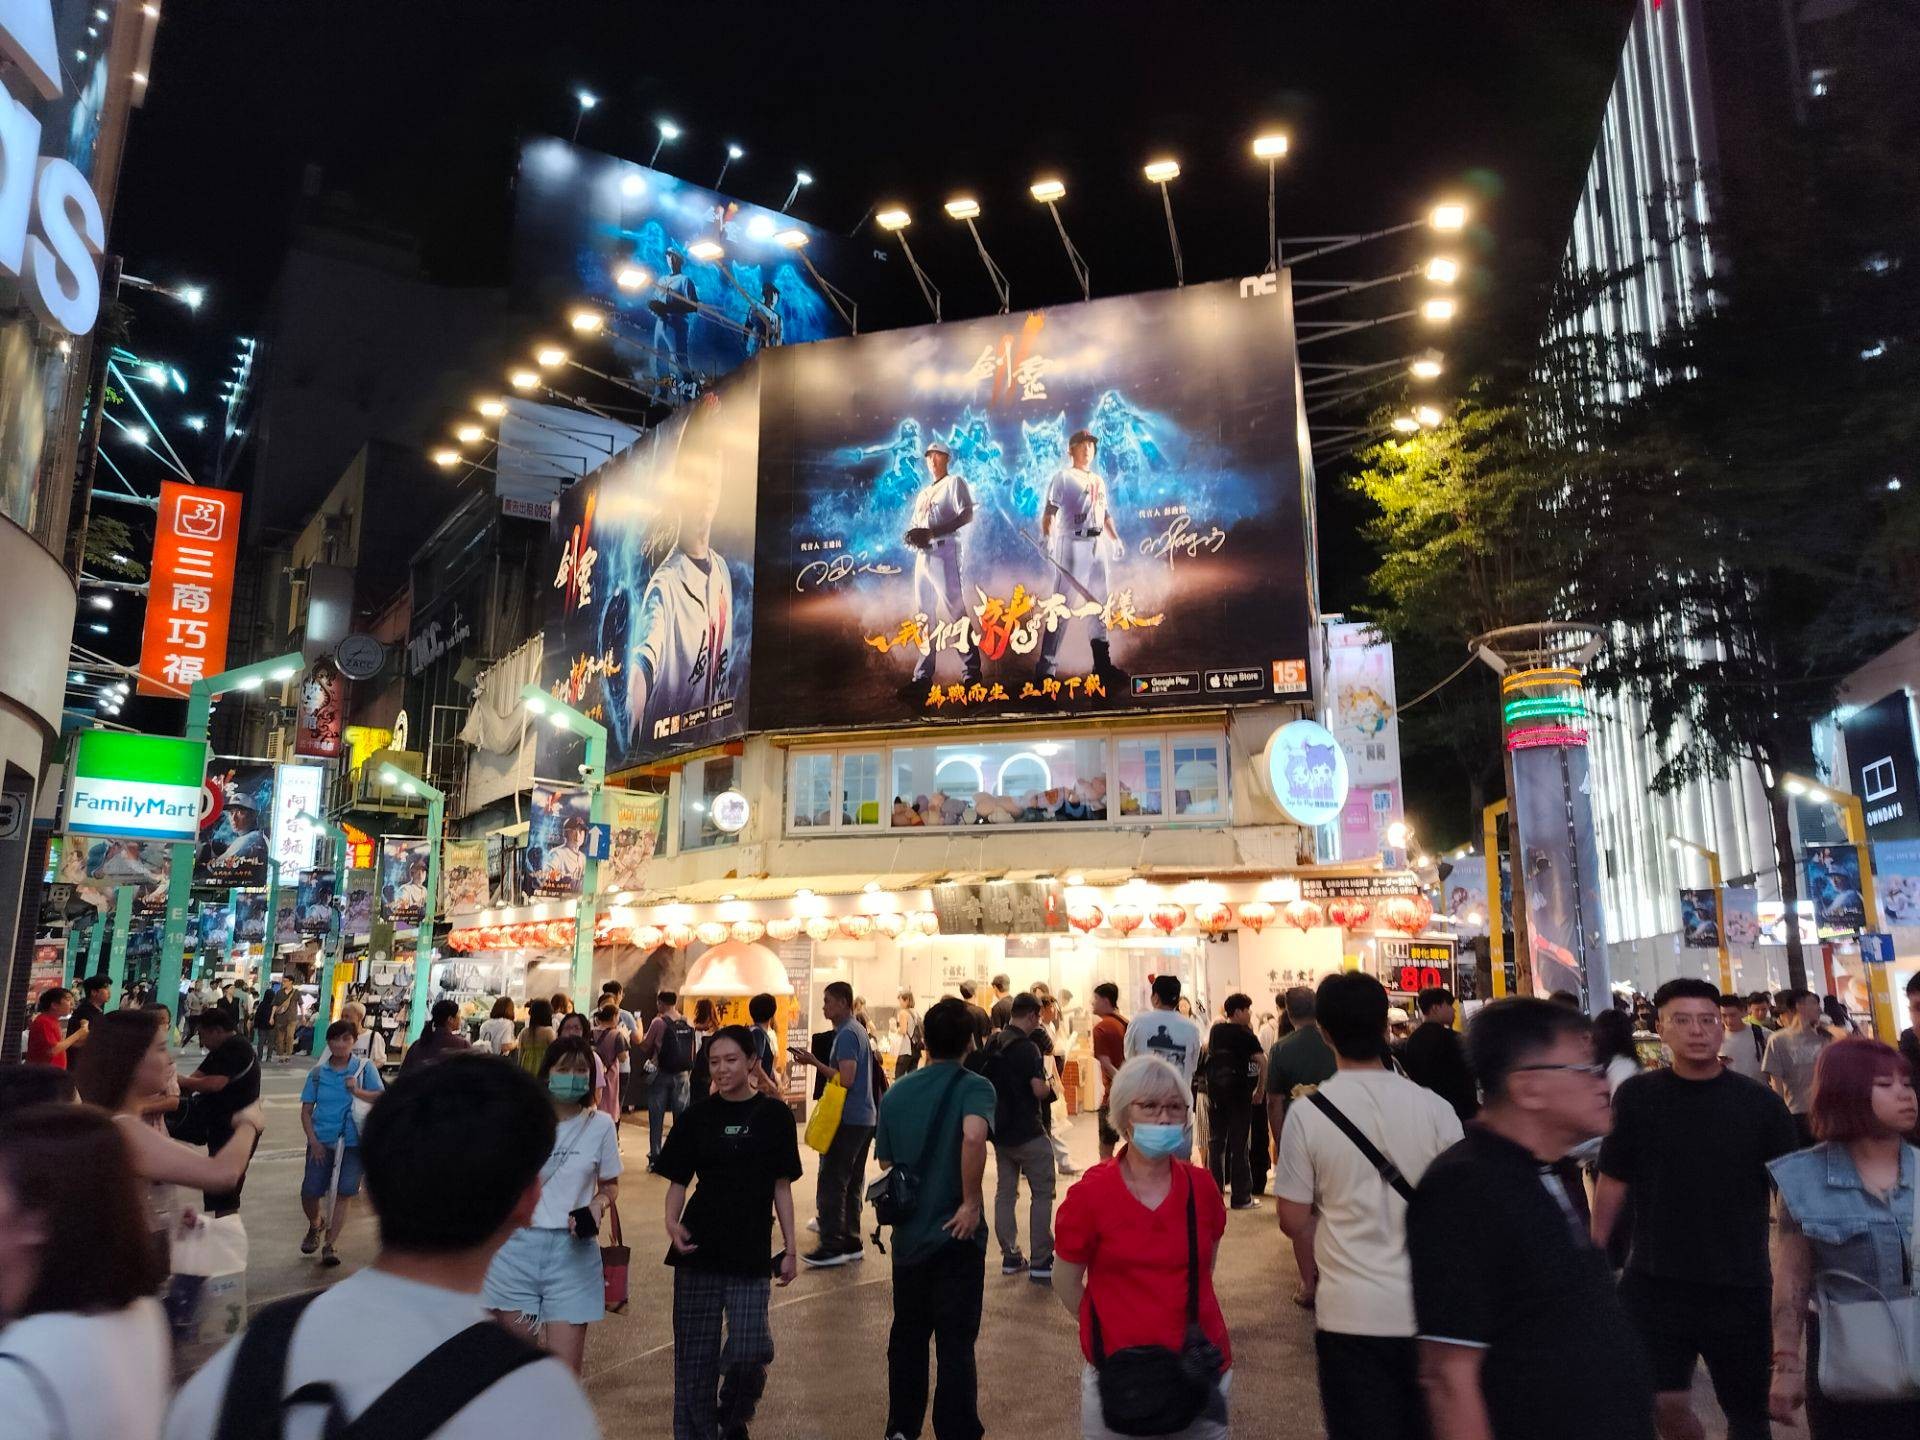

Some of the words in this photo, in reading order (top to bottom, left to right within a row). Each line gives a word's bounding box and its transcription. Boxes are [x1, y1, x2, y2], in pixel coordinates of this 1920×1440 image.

[162, 546, 214, 685] 三商巧福
[1019, 673, 1107, 700] 立即下載
[1151, 677, 1175, 688] Google
[1223, 673, 1239, 686] App
[1239, 671, 1259, 682] Store
[74, 791, 197, 819] FamilyMart
[1866, 802, 1904, 827] OWNDAYS
[171, 907, 183, 920] E
[167, 932, 184, 944] 19
[112, 945, 124, 955] 17
[1400, 966, 1441, 992] 80
